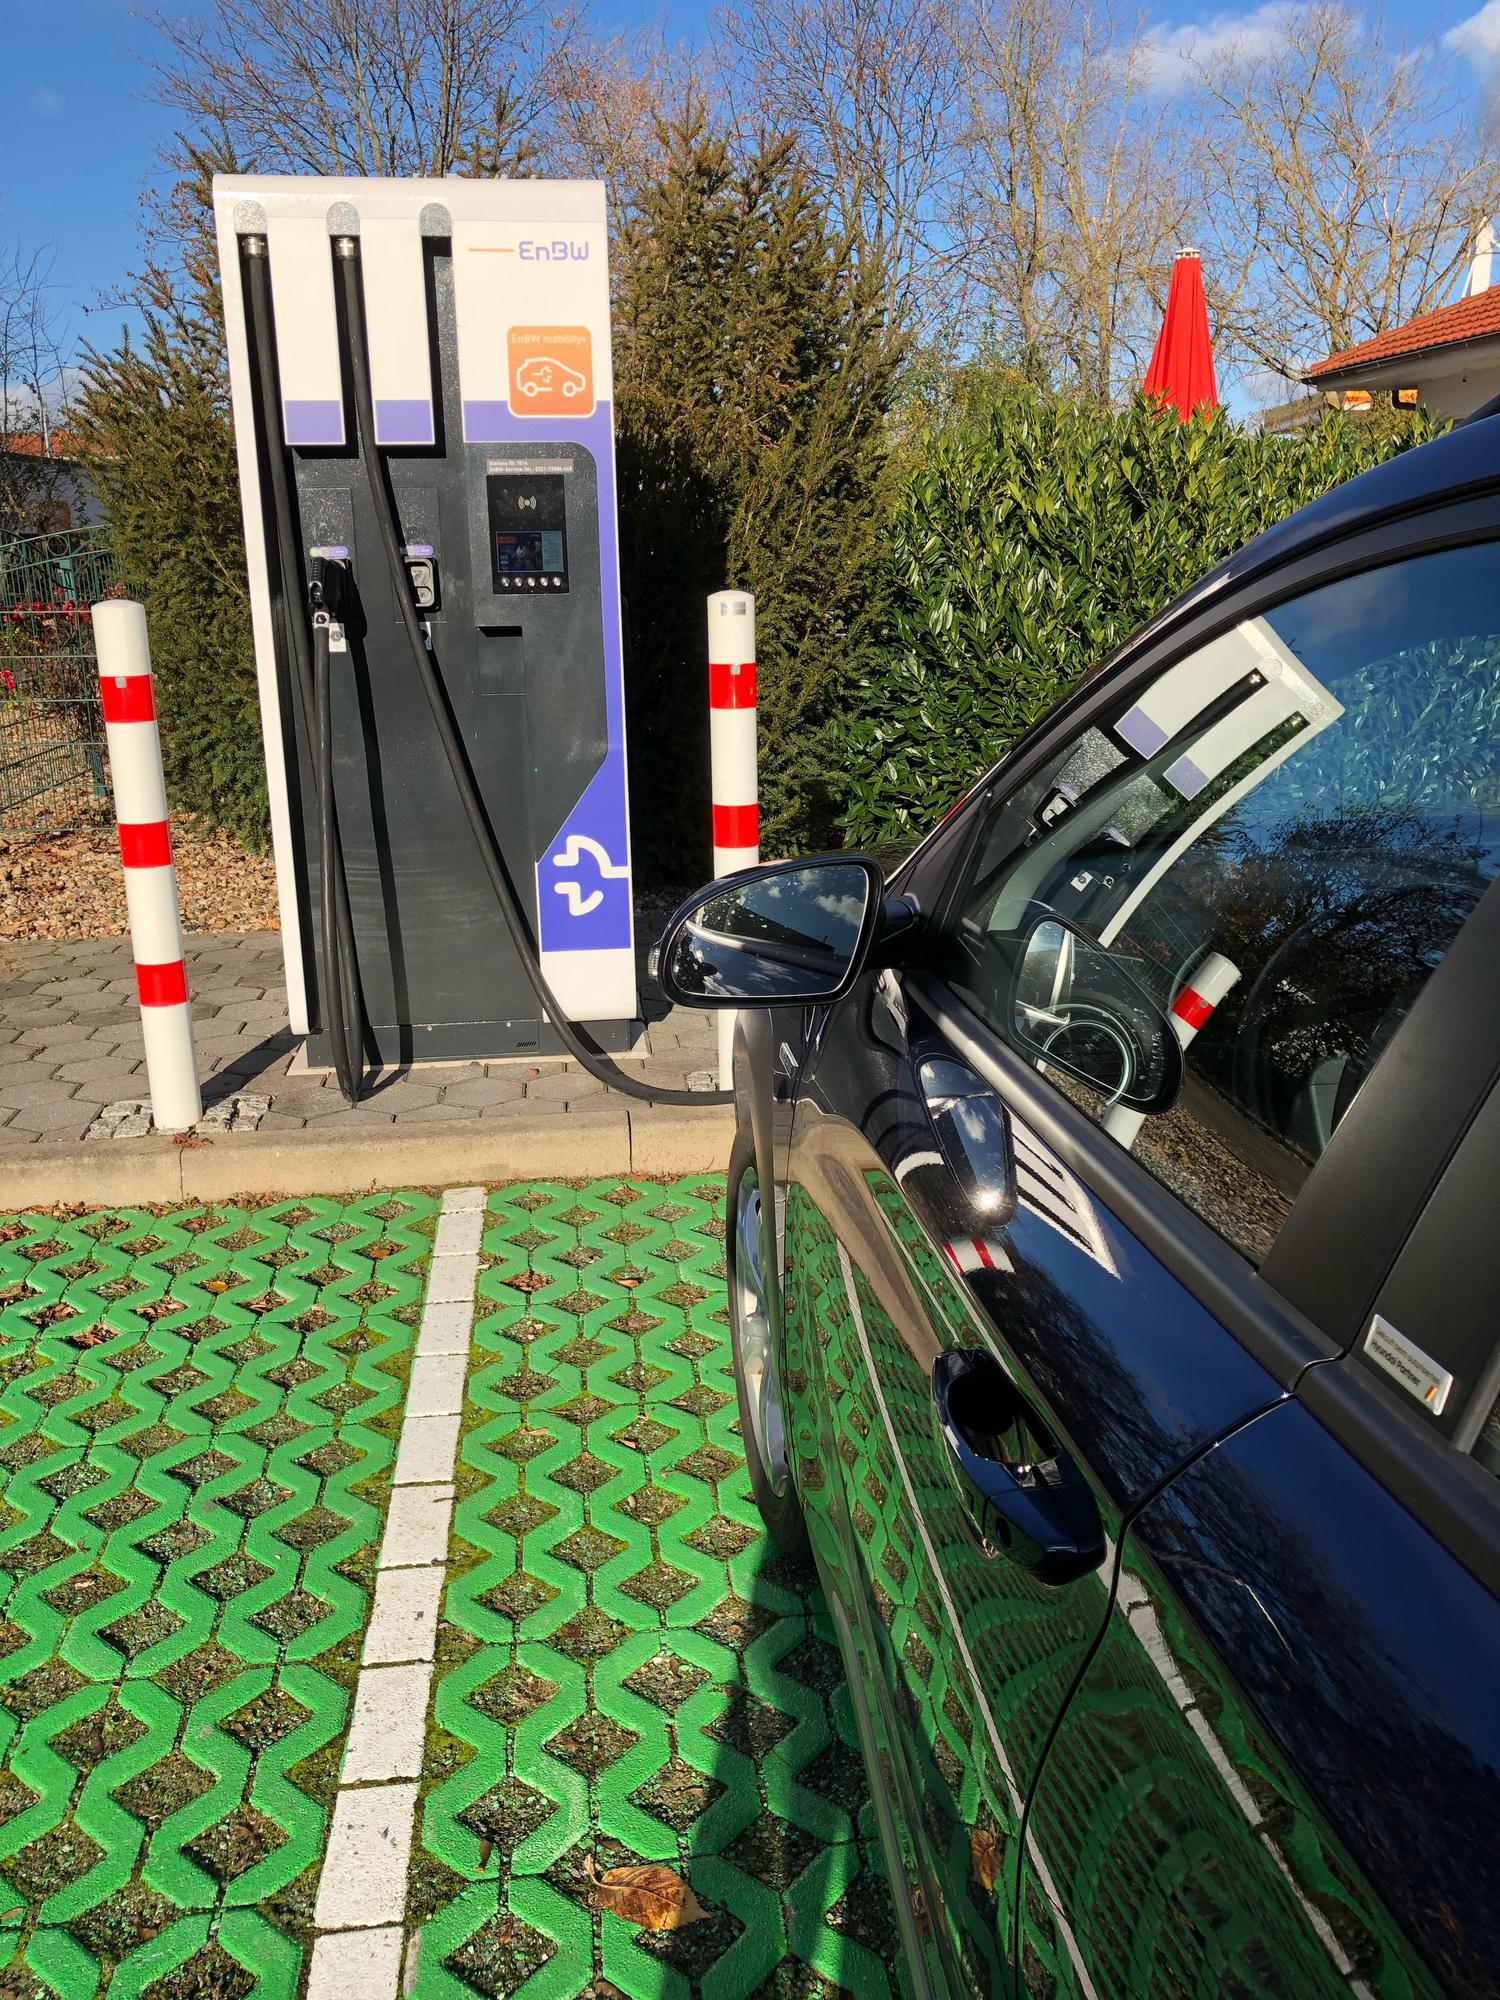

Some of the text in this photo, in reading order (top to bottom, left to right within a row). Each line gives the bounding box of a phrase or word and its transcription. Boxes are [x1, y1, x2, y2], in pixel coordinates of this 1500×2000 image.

[518, 240, 590, 261] EnBW
[511, 333, 541, 344] EnBW
[1371, 1338, 1397, 1367] Hyundai
